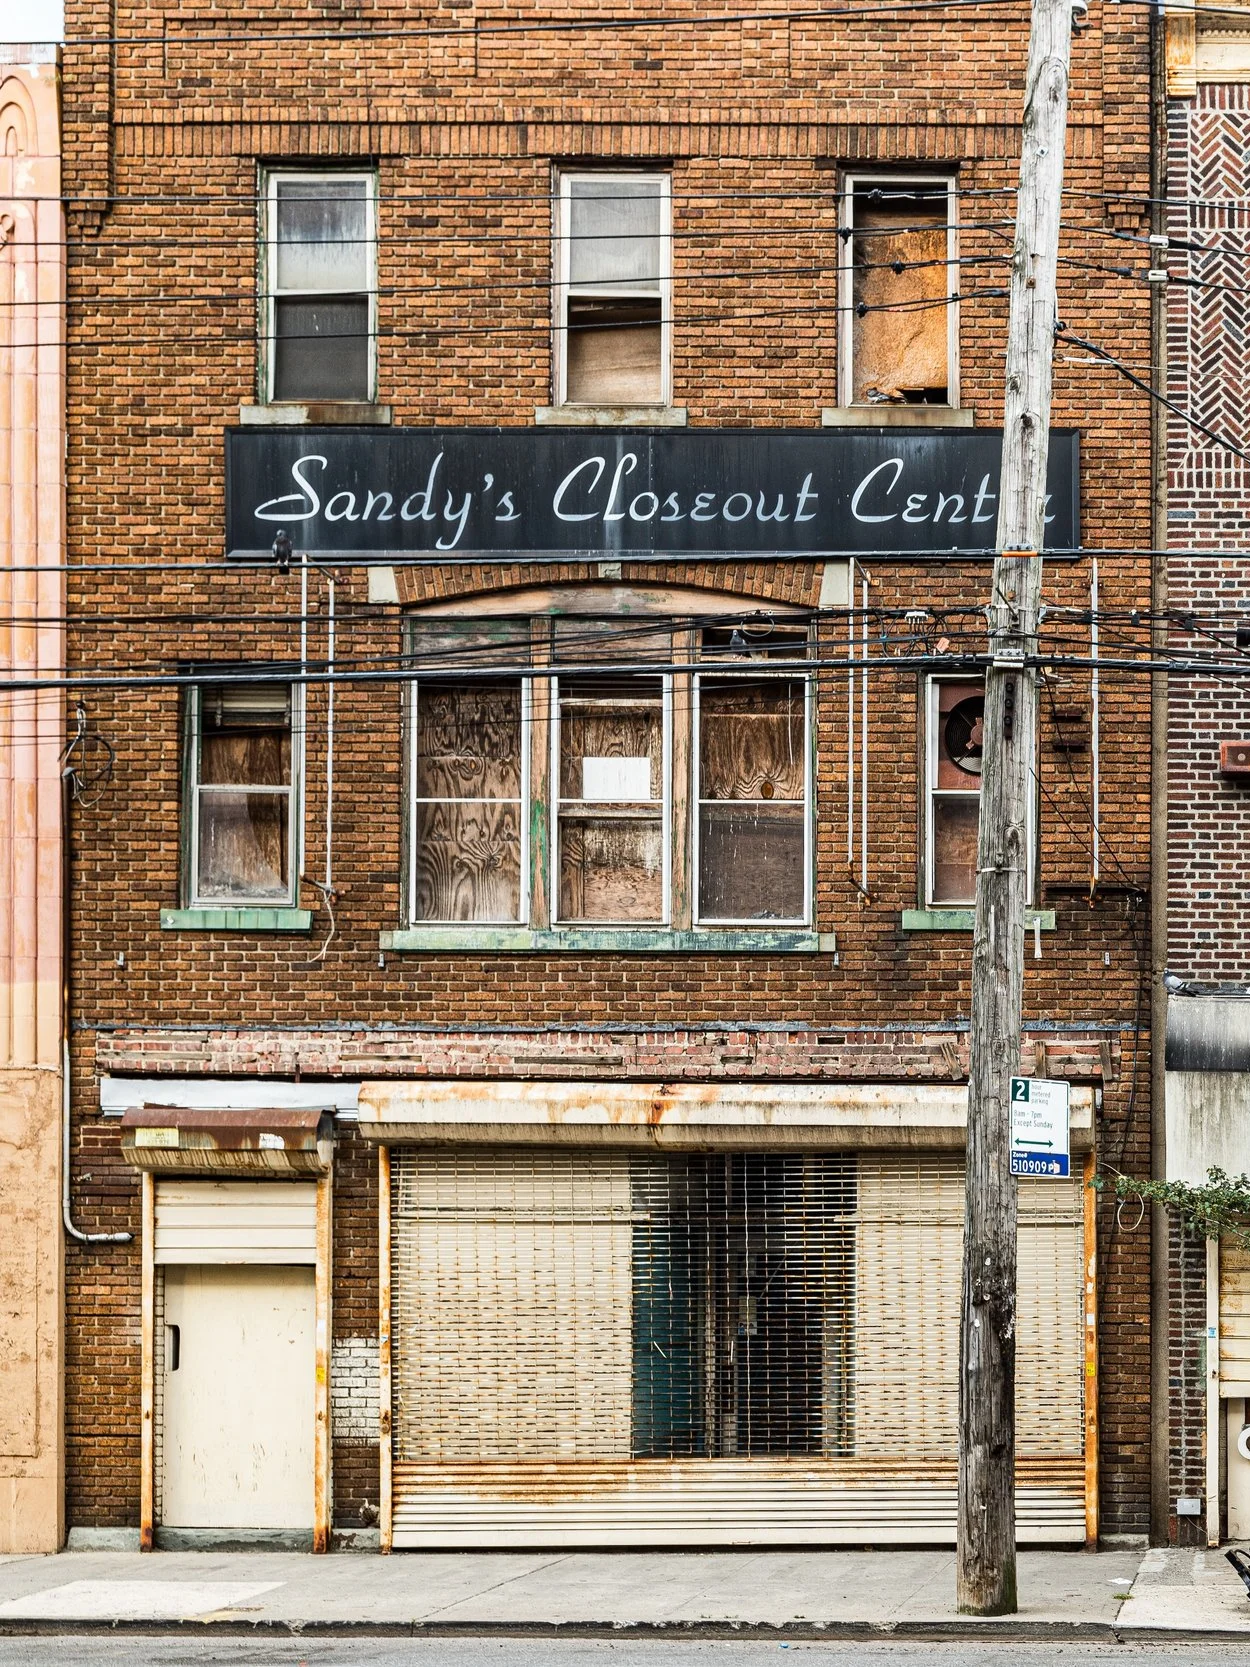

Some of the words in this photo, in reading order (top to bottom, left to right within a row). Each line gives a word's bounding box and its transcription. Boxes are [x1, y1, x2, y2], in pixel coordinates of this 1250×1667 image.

[254, 451, 522, 551] Sandy's
[552, 452, 819, 522] Closeout
[851, 457, 1055, 523] Cent
[1015, 1080, 1026, 1101] 2
[1013, 1109, 1026, 1117] 8am
[1030, 1110, 1043, 1119] 7pm
[1013, 1118, 1033, 1128] Except
[1033, 1120, 1054, 1129] Sunday
[1012, 1159, 1047, 1173] 510909
